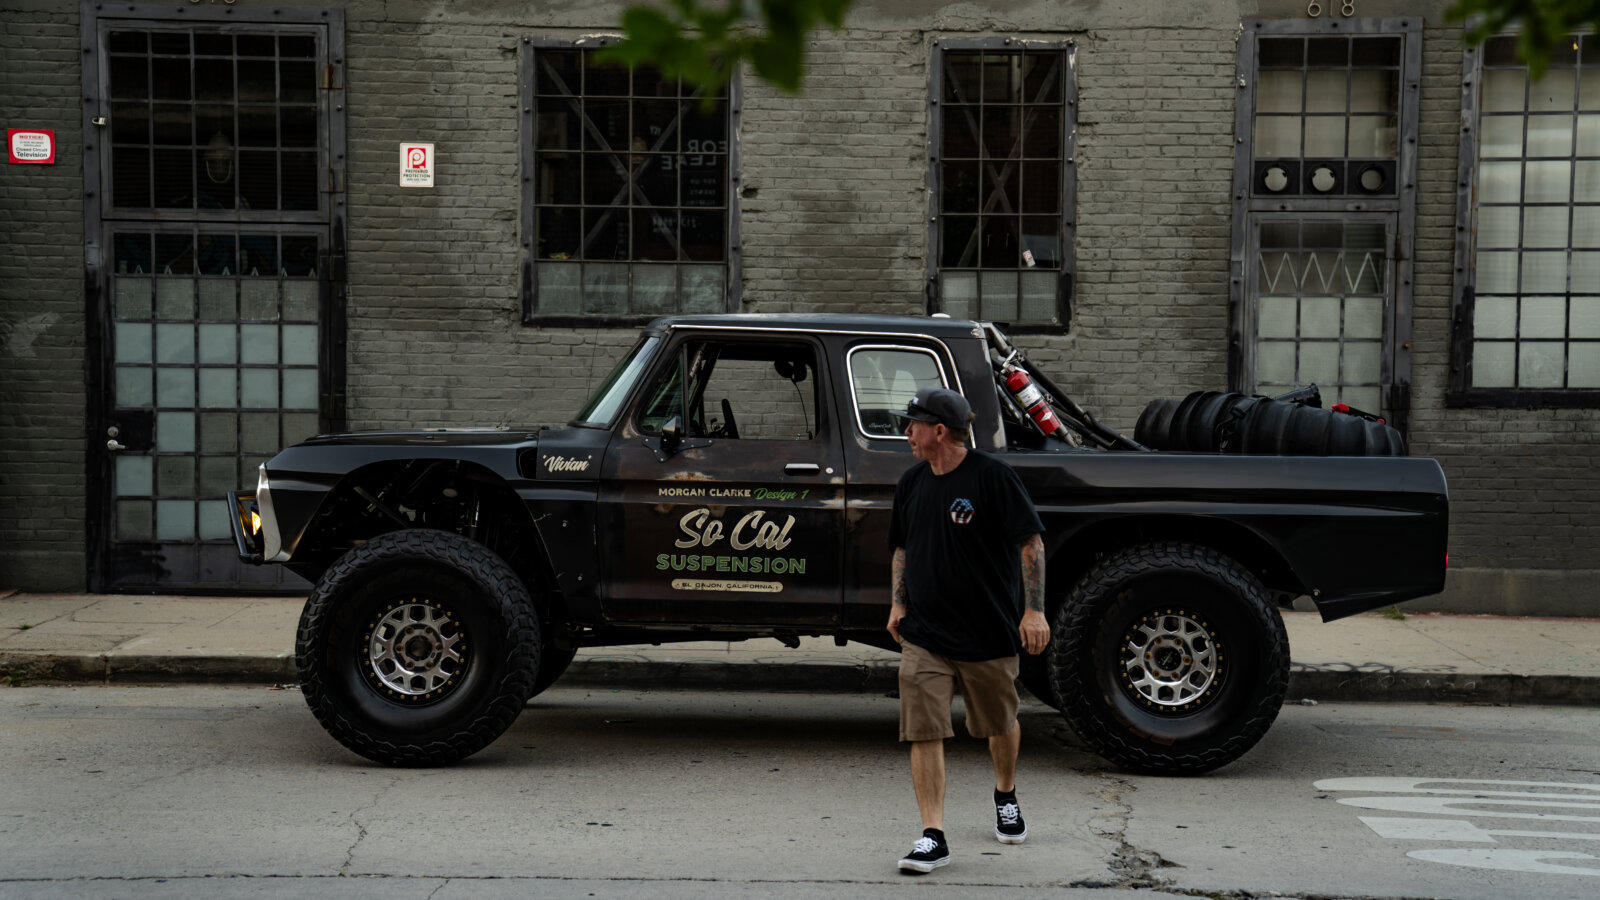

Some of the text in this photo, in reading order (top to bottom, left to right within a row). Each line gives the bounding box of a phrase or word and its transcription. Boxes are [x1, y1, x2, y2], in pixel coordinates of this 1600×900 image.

[1307, 0, 1354, 17] 618
[658, 488, 706, 497] MORGAN
[709, 488, 751, 497] CLARKE
[753, 487, 797, 501] Design
[674, 508, 796, 551] So Cal
[656, 553, 807, 575] SUSPENSION
